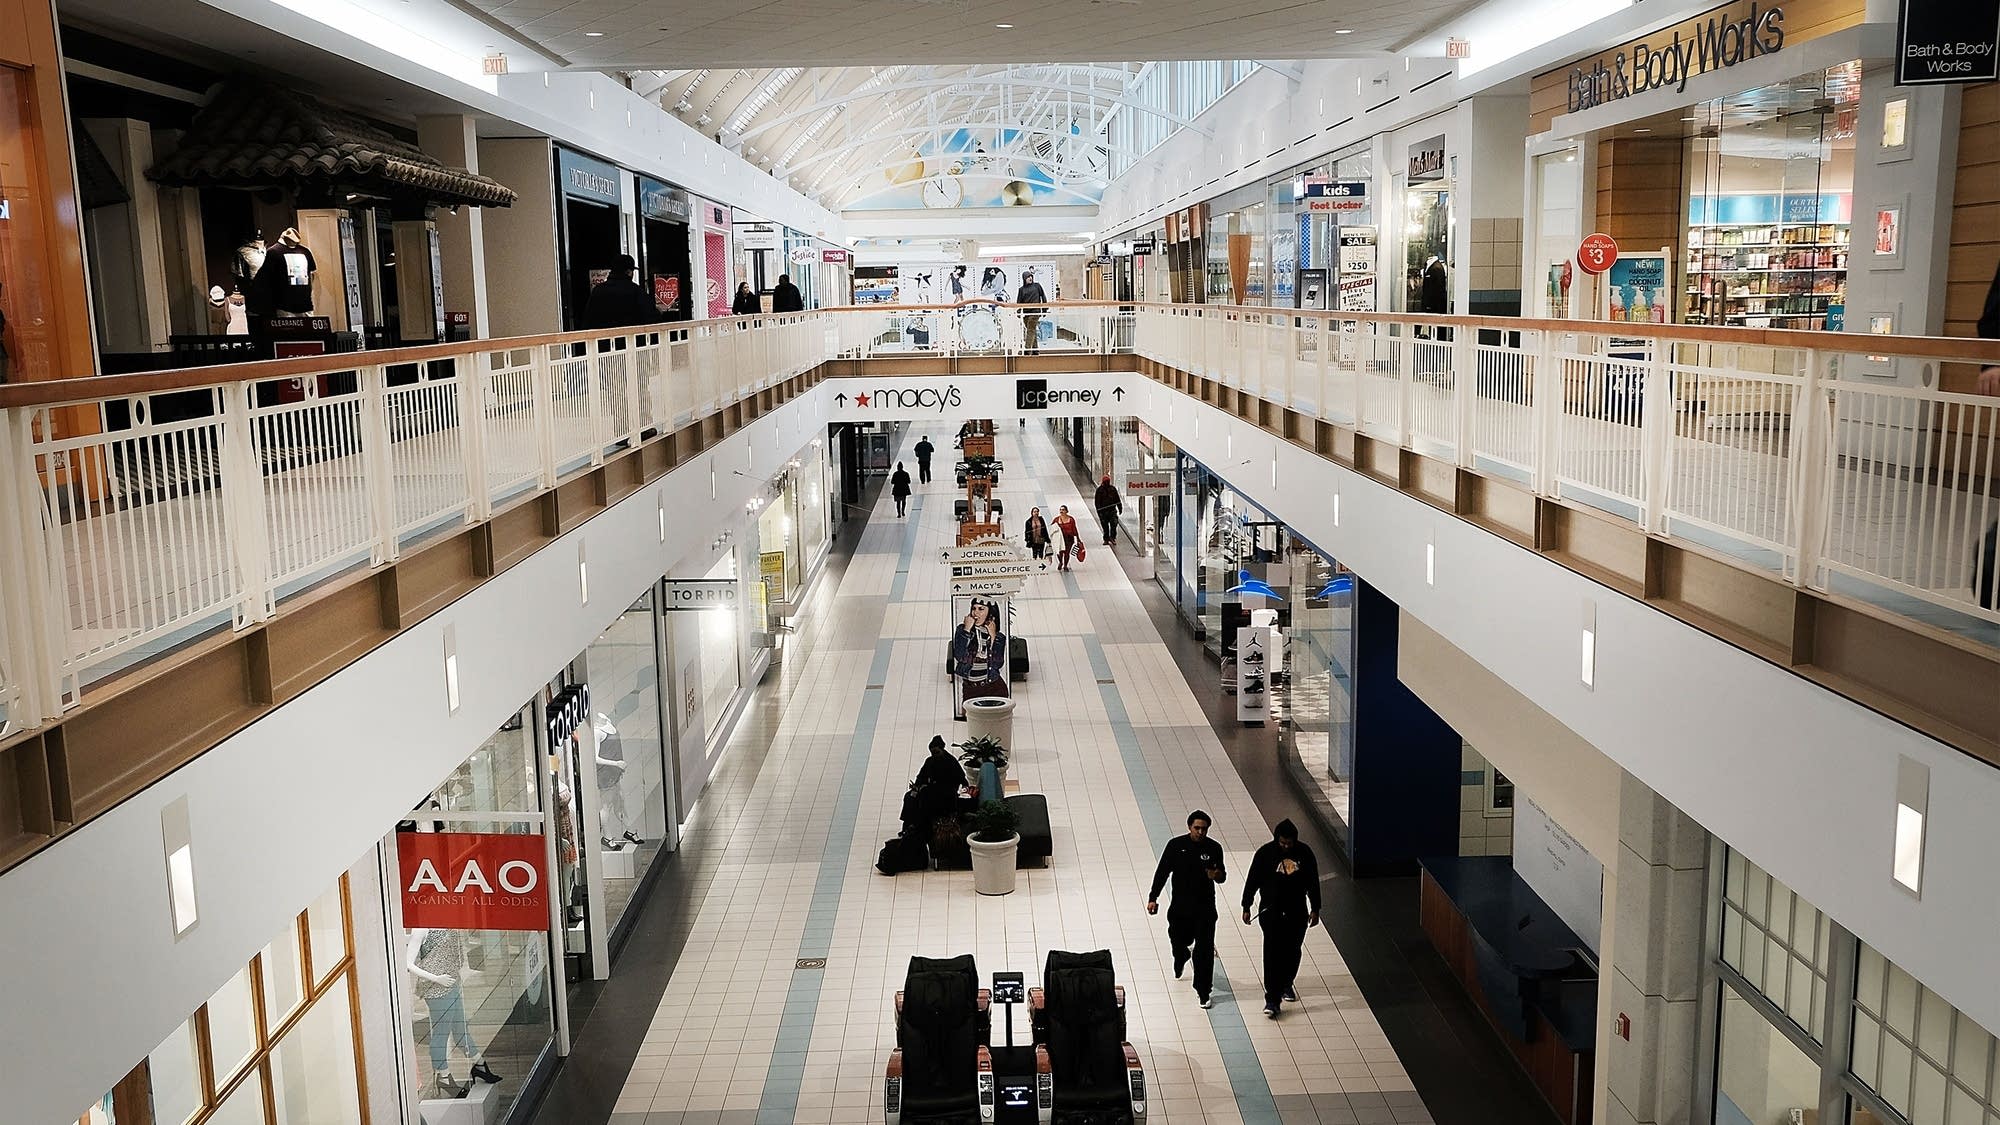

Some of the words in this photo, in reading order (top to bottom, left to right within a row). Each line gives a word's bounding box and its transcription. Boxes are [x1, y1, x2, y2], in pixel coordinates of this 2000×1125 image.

[1449, 42, 1469, 57] EXIT
[1907, 44, 1941, 58] Bath
[1942, 43, 1953, 56] &
[1955, 41, 1994, 57] Body
[1567, 58, 1611, 114] Bath
[1613, 51, 1630, 100] &
[1632, 30, 1695, 94] Body
[1696, 1, 1785, 75] Works
[484, 58, 504, 73] EXIT
[1926, 59, 1973, 73] Works
[1322, 184, 1351, 197] kids
[1309, 201, 1330, 211] Foot
[1332, 200, 1363, 210] Locker
[1346, 237, 1372, 246] SALE
[791, 249, 816, 261] Justice
[1589, 248, 1604, 264] $3
[1348, 262, 1368, 270] $250
[1635, 261, 1655, 269] NEW!
[1341, 278, 1373, 290] SPECIAL
[1629, 278, 1662, 286] COCONUT
[660, 291, 675, 299] FREE
[271, 319, 305, 327] CLEARANCE
[873, 384, 962, 413] macy's
[1020, 387, 1102, 408] jcpenney
[1128, 481, 1145, 489] Foot
[1145, 481, 1169, 489] Locker
[974, 567, 997, 575] MALL
[999, 565, 1031, 573] OFFICE
[969, 582, 1003, 591] MACY'S
[672, 589, 735, 601] TORRID
[549, 683, 590, 750] TORRID
[408, 858, 538, 895] AAO
[409, 894, 466, 906] AGAINST
[471, 895, 496, 907] ALL
[500, 895, 539, 907] ODDS
